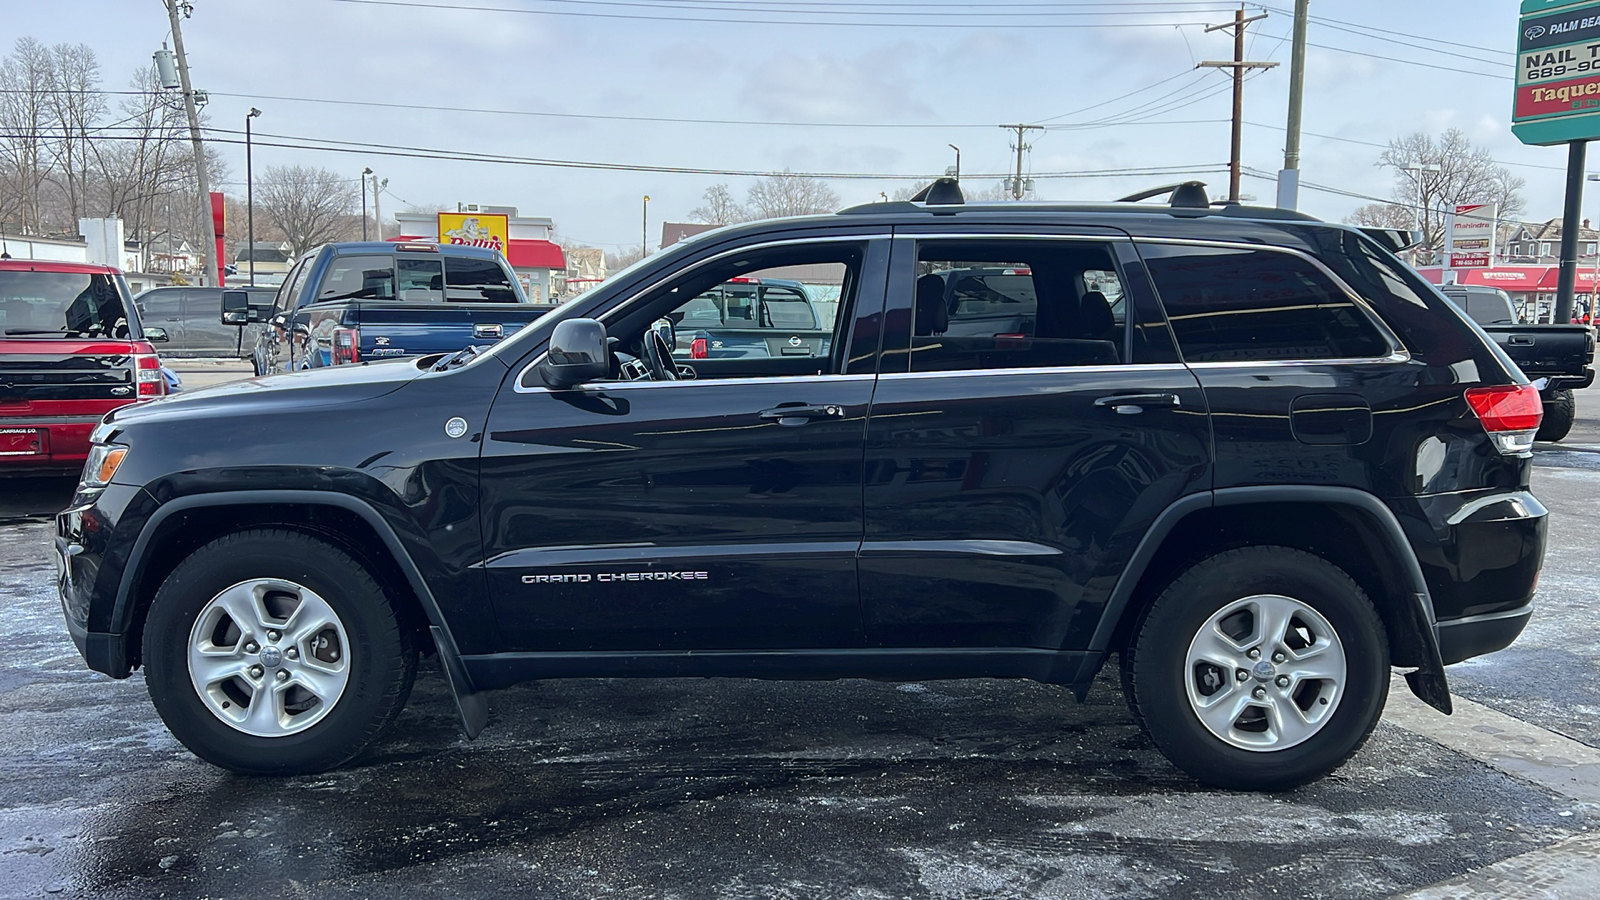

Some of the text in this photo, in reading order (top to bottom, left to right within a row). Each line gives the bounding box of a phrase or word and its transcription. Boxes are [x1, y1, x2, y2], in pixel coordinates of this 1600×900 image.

[1549, 20, 1579, 35] PALM
[1526, 49, 1577, 69] NAIL
[521, 571, 709, 584] GRAND CHEROKEE
